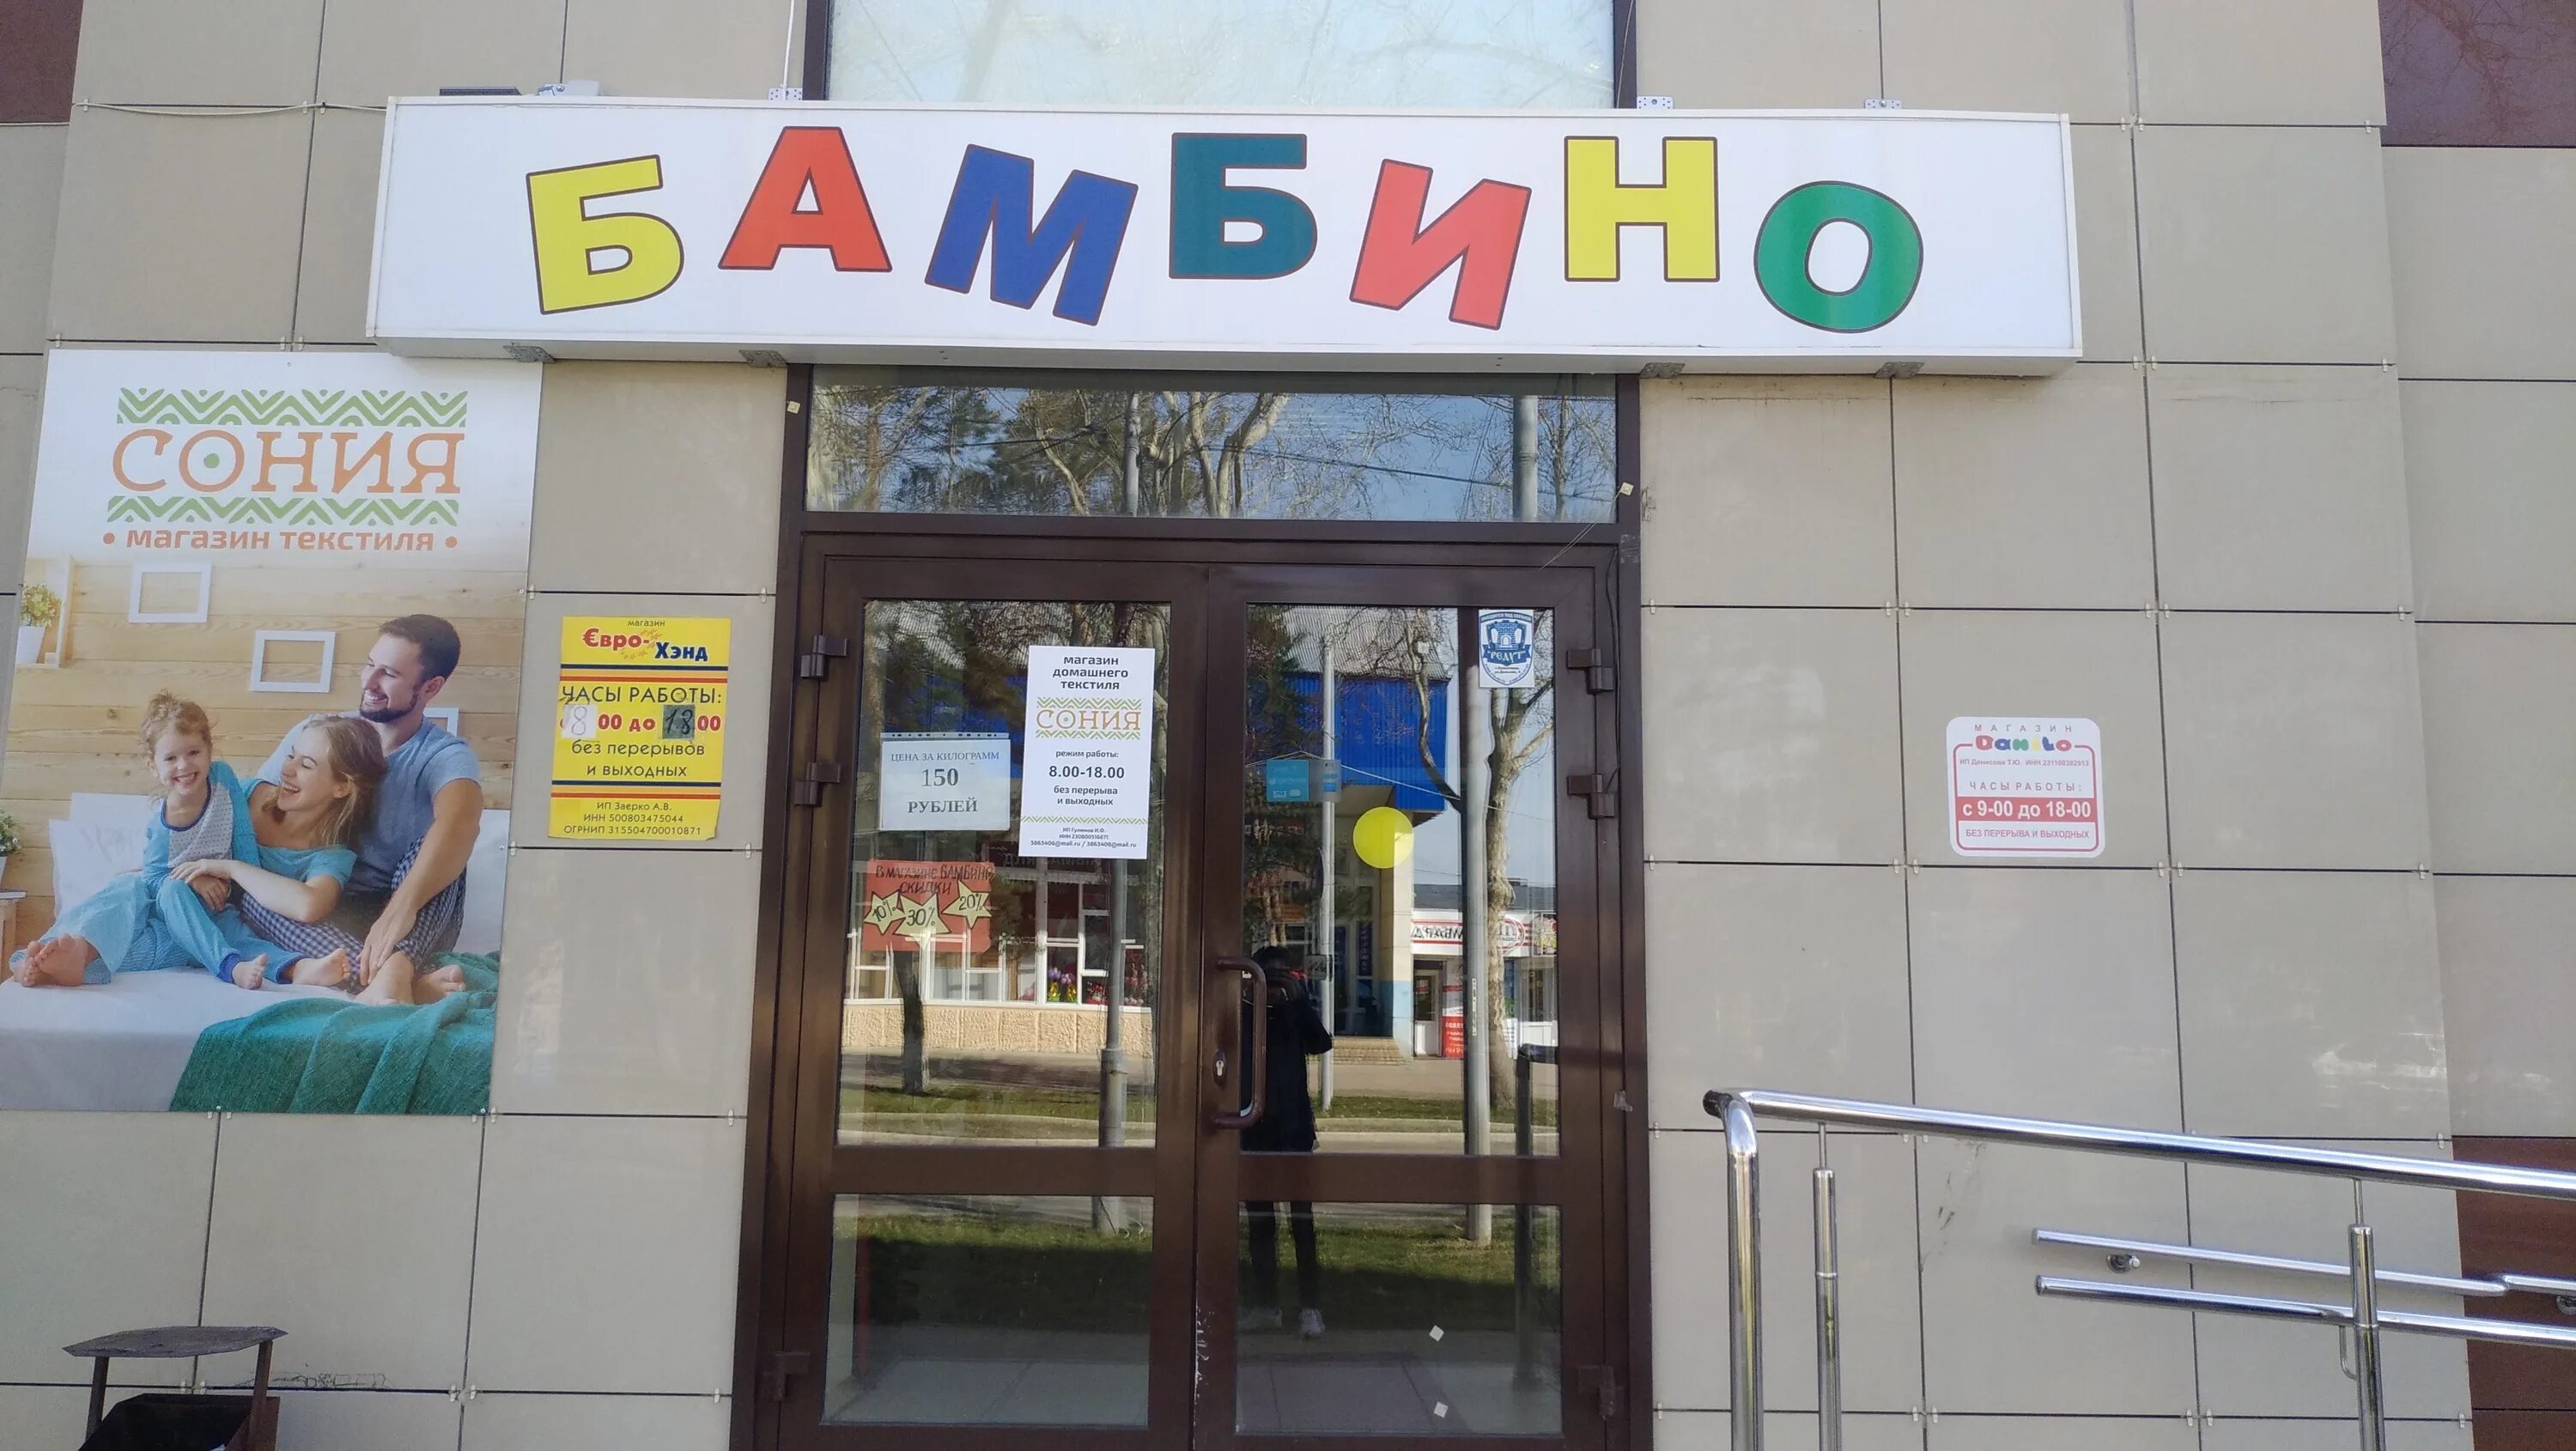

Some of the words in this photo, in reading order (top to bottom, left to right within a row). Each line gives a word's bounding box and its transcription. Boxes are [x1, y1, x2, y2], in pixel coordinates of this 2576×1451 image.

[526, 125, 1923, 333] БАМБИНО
[112, 429, 465, 495] СОНИЯ
[127, 530, 270, 549] магазин
[280, 531, 434, 551] текстиля
[654, 642, 708, 661] Хэнд
[1064, 656, 1118, 665] магазин
[1053, 668, 1128, 678] домашнего
[1060, 680, 1120, 689] текстиля
[562, 687, 620, 702] ЧАСЫ
[629, 687, 721, 703] РАБОТЫ:
[571, 706, 587, 736] 8
[598, 714, 622, 730] 00
[629, 718, 656, 732] до
[697, 715, 721, 731] 00
[1036, 709, 1141, 730] СОНИЯ
[572, 740, 601, 755] без
[607, 743, 705, 757] перерывов
[891, 753, 919, 762] ЦЕНА
[937, 752, 999, 761] КИЛОГРАММ
[587, 767, 596, 776] и
[603, 766, 687, 778] выходных
[922, 768, 958, 786] 150
[1049, 766, 1125, 779] 8.00-18.00
[1072, 787, 1117, 796] перерыва
[615, 803, 649, 812] Заерко
[908, 798, 978, 813] РУБЛЕЙ
[1963, 804, 1972, 816] с
[1978, 800, 2013, 816] 9-00
[2018, 804, 2040, 819] до
[2046, 801, 2091, 817] 18-00
[608, 826, 701, 835] 315504700010871
[876, 865, 884, 877] В
[958, 893, 984, 911] 20%
[872, 901, 896, 922] 10%
[906, 907, 935, 927] 30%
